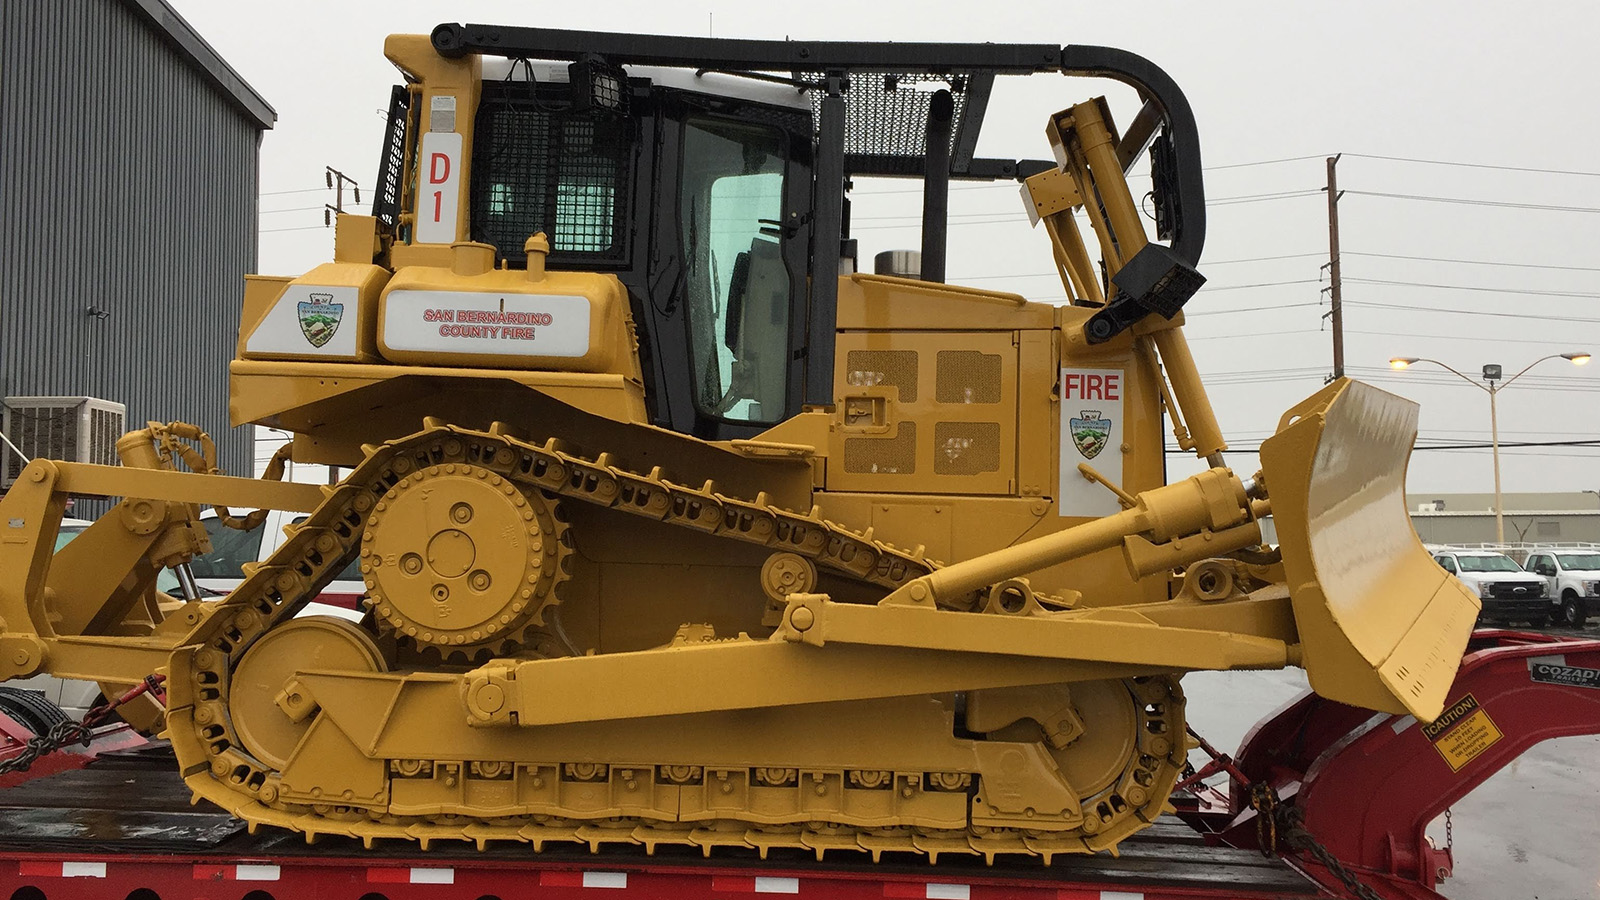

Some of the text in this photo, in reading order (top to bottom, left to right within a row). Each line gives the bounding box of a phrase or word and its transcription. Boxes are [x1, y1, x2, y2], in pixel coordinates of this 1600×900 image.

[430, 152, 451, 184] D
[433, 190, 442, 222] 1
[423, 308, 553, 326] SAN BERNARDINO
[438, 323, 536, 341] COUNTY FIRE
[1065, 374, 1119, 401] FIRE
[1443, 716, 1476, 742] STAND CLEAR
[1449, 725, 1486, 754] WHEN LOADING
[1461, 726, 1474, 737] FEET
[1455, 731, 1489, 758] OR DROPPING
[1465, 741, 1486, 758] TRAILER
